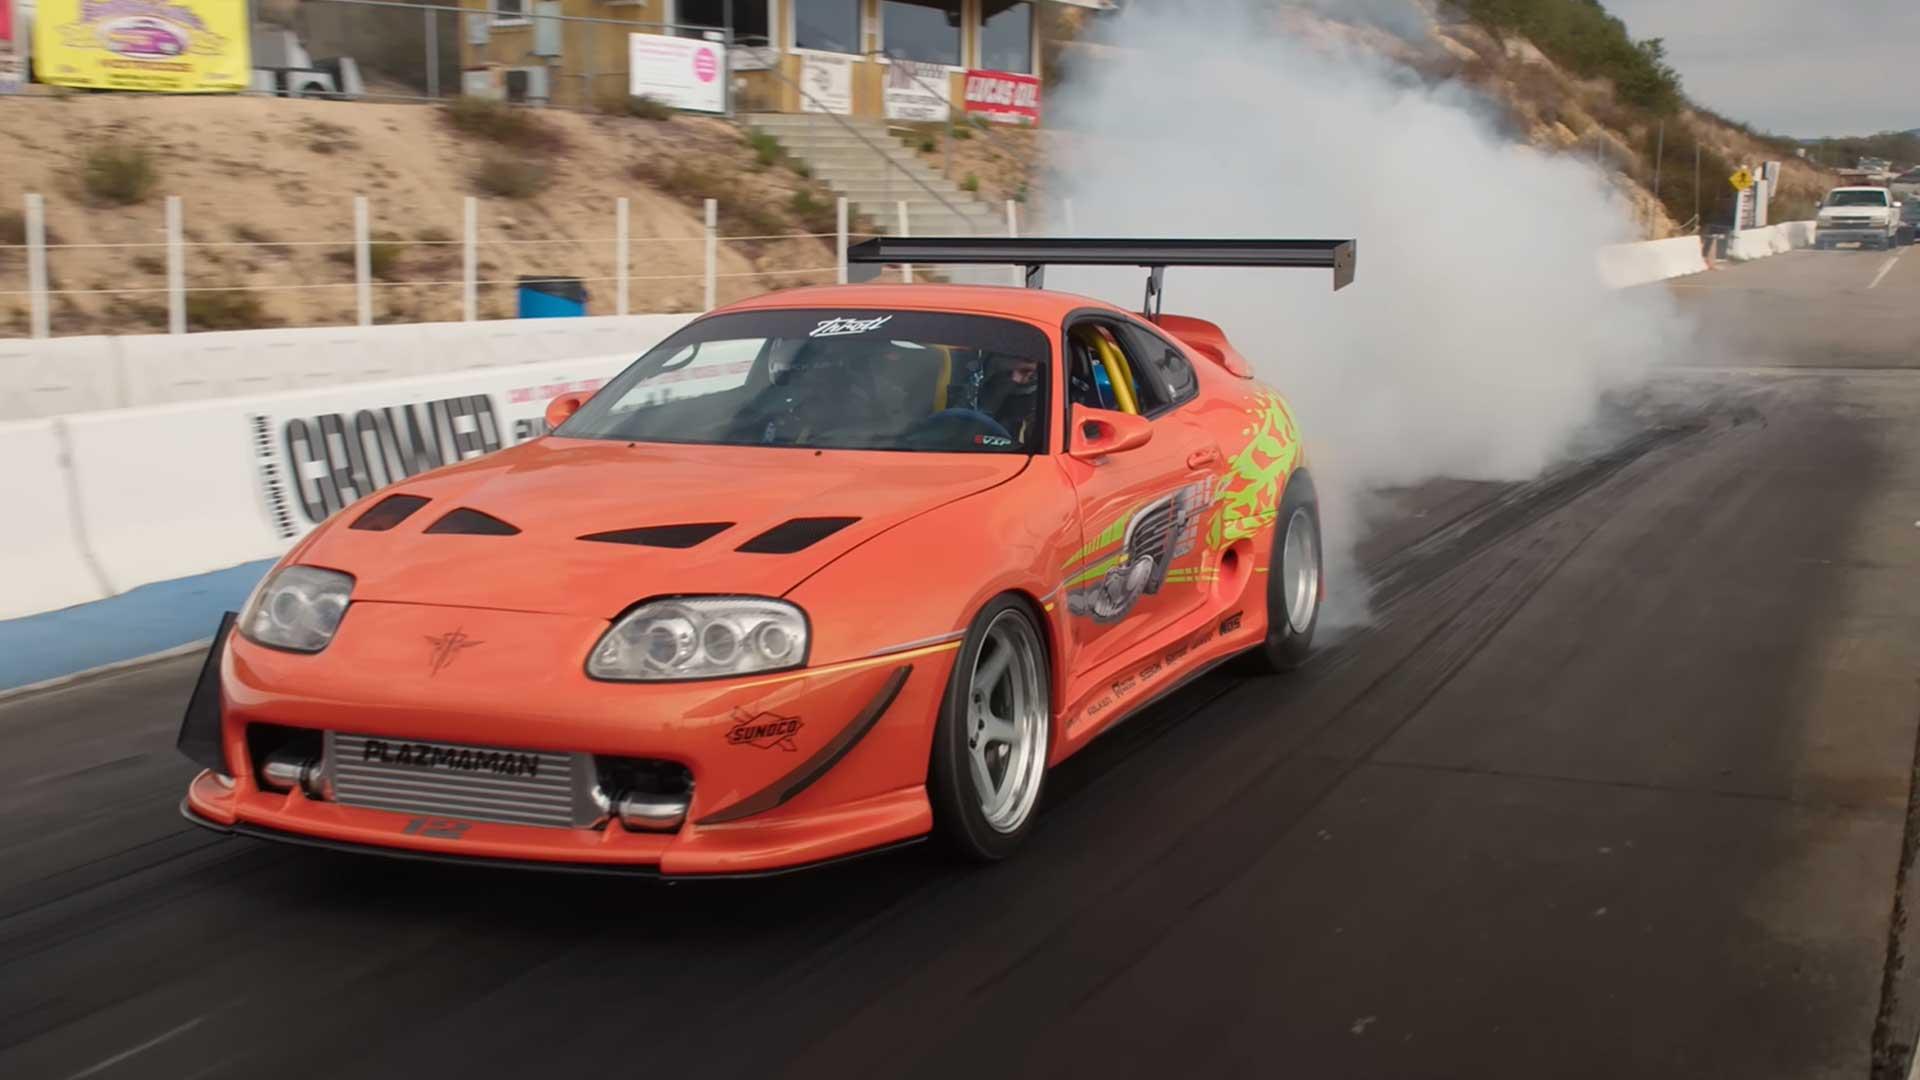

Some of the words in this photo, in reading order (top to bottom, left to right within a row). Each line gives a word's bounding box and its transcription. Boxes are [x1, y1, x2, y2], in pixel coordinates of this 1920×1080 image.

[285, 393, 502, 524] CROWER
[733, 720, 798, 741] SUNOCO
[364, 740, 540, 777] PLAZMAMAN
[404, 817, 473, 840] 12
